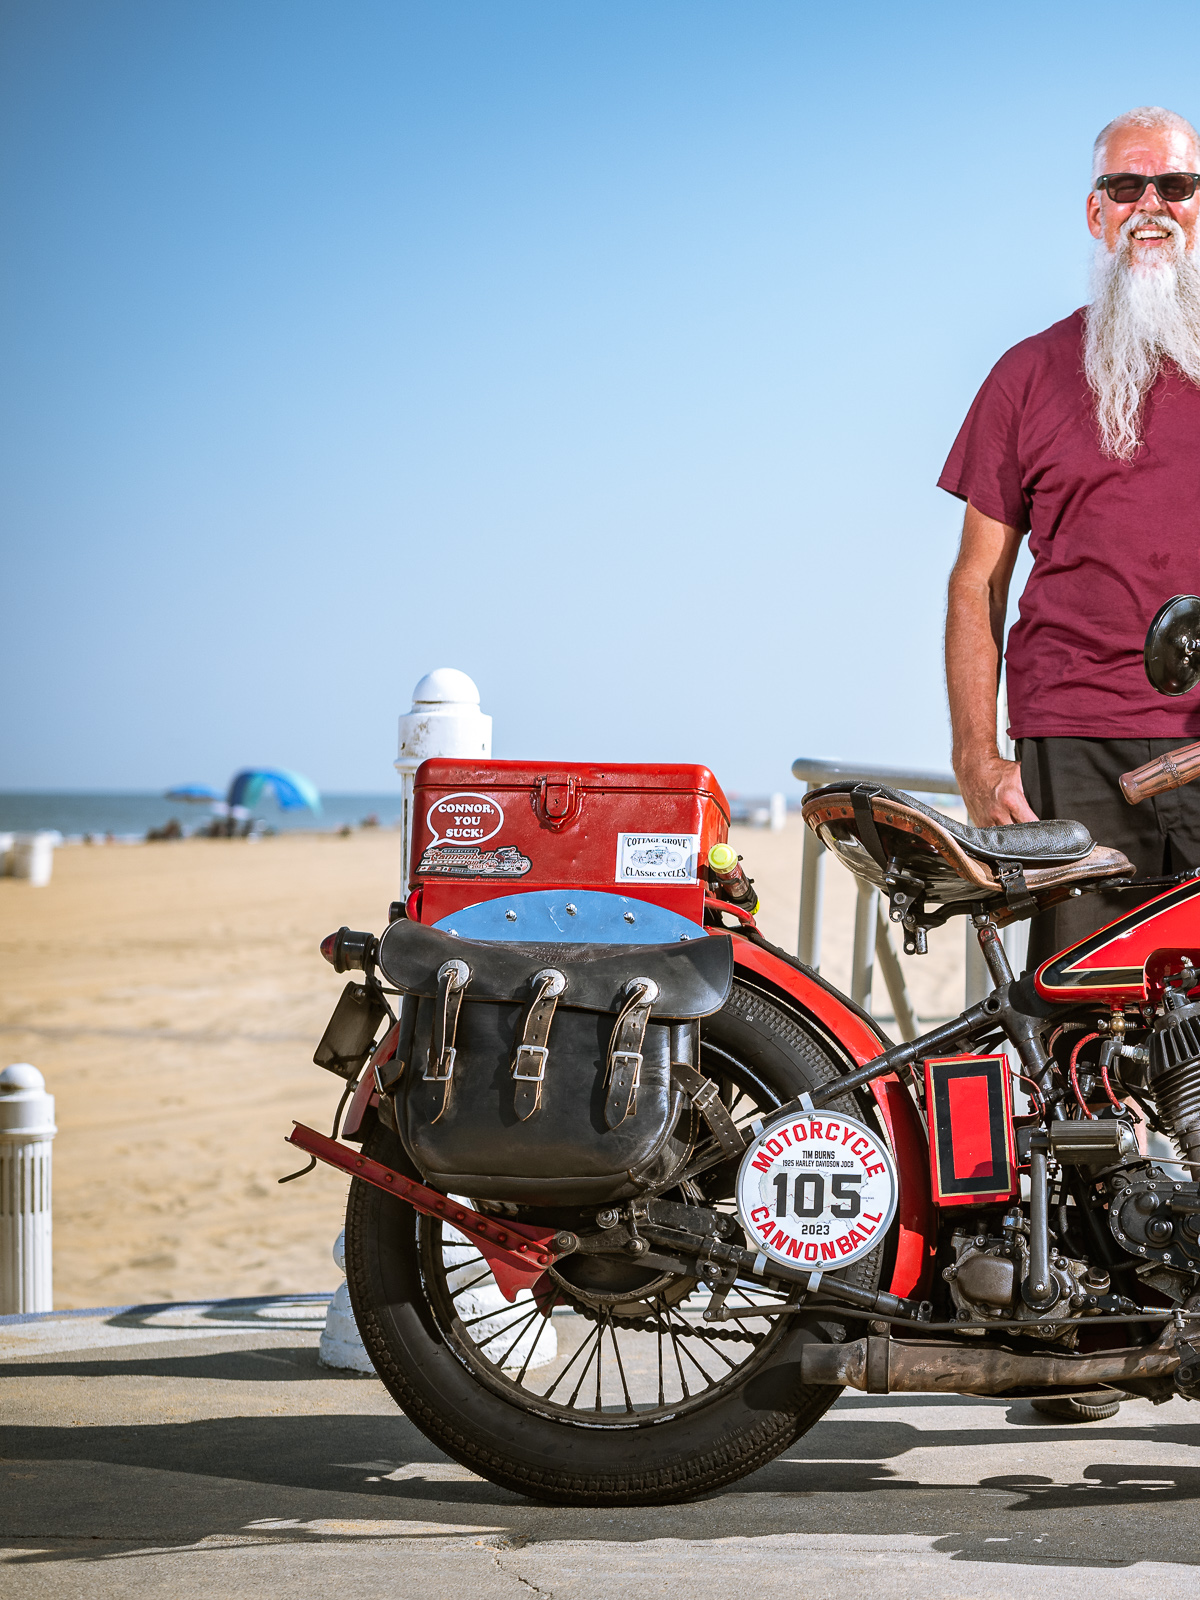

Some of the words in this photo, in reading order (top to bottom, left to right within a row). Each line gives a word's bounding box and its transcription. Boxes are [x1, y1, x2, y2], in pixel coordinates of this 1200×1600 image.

[438, 803, 495, 815] CONNOR,
[453, 816, 481, 826] YOU
[445, 828, 484, 838] SUCK!
[626, 837, 660, 847] COTTAGE
[661, 838, 688, 849] GROVE
[625, 866, 656, 877] CLASSIC
[657, 867, 687, 878] CYCLES
[751, 1121, 886, 1178] MOTORCYCLE
[802, 1150, 813, 1159] TIM
[814, 1151, 835, 1159] BURNS
[782, 1159, 795, 1167] 1925
[815, 1160, 840, 1168] DAVIDSON
[772, 1172, 862, 1219] 105
[750, 1206, 883, 1262] CANNONBALL
[801, 1224, 830, 1235] 2023
